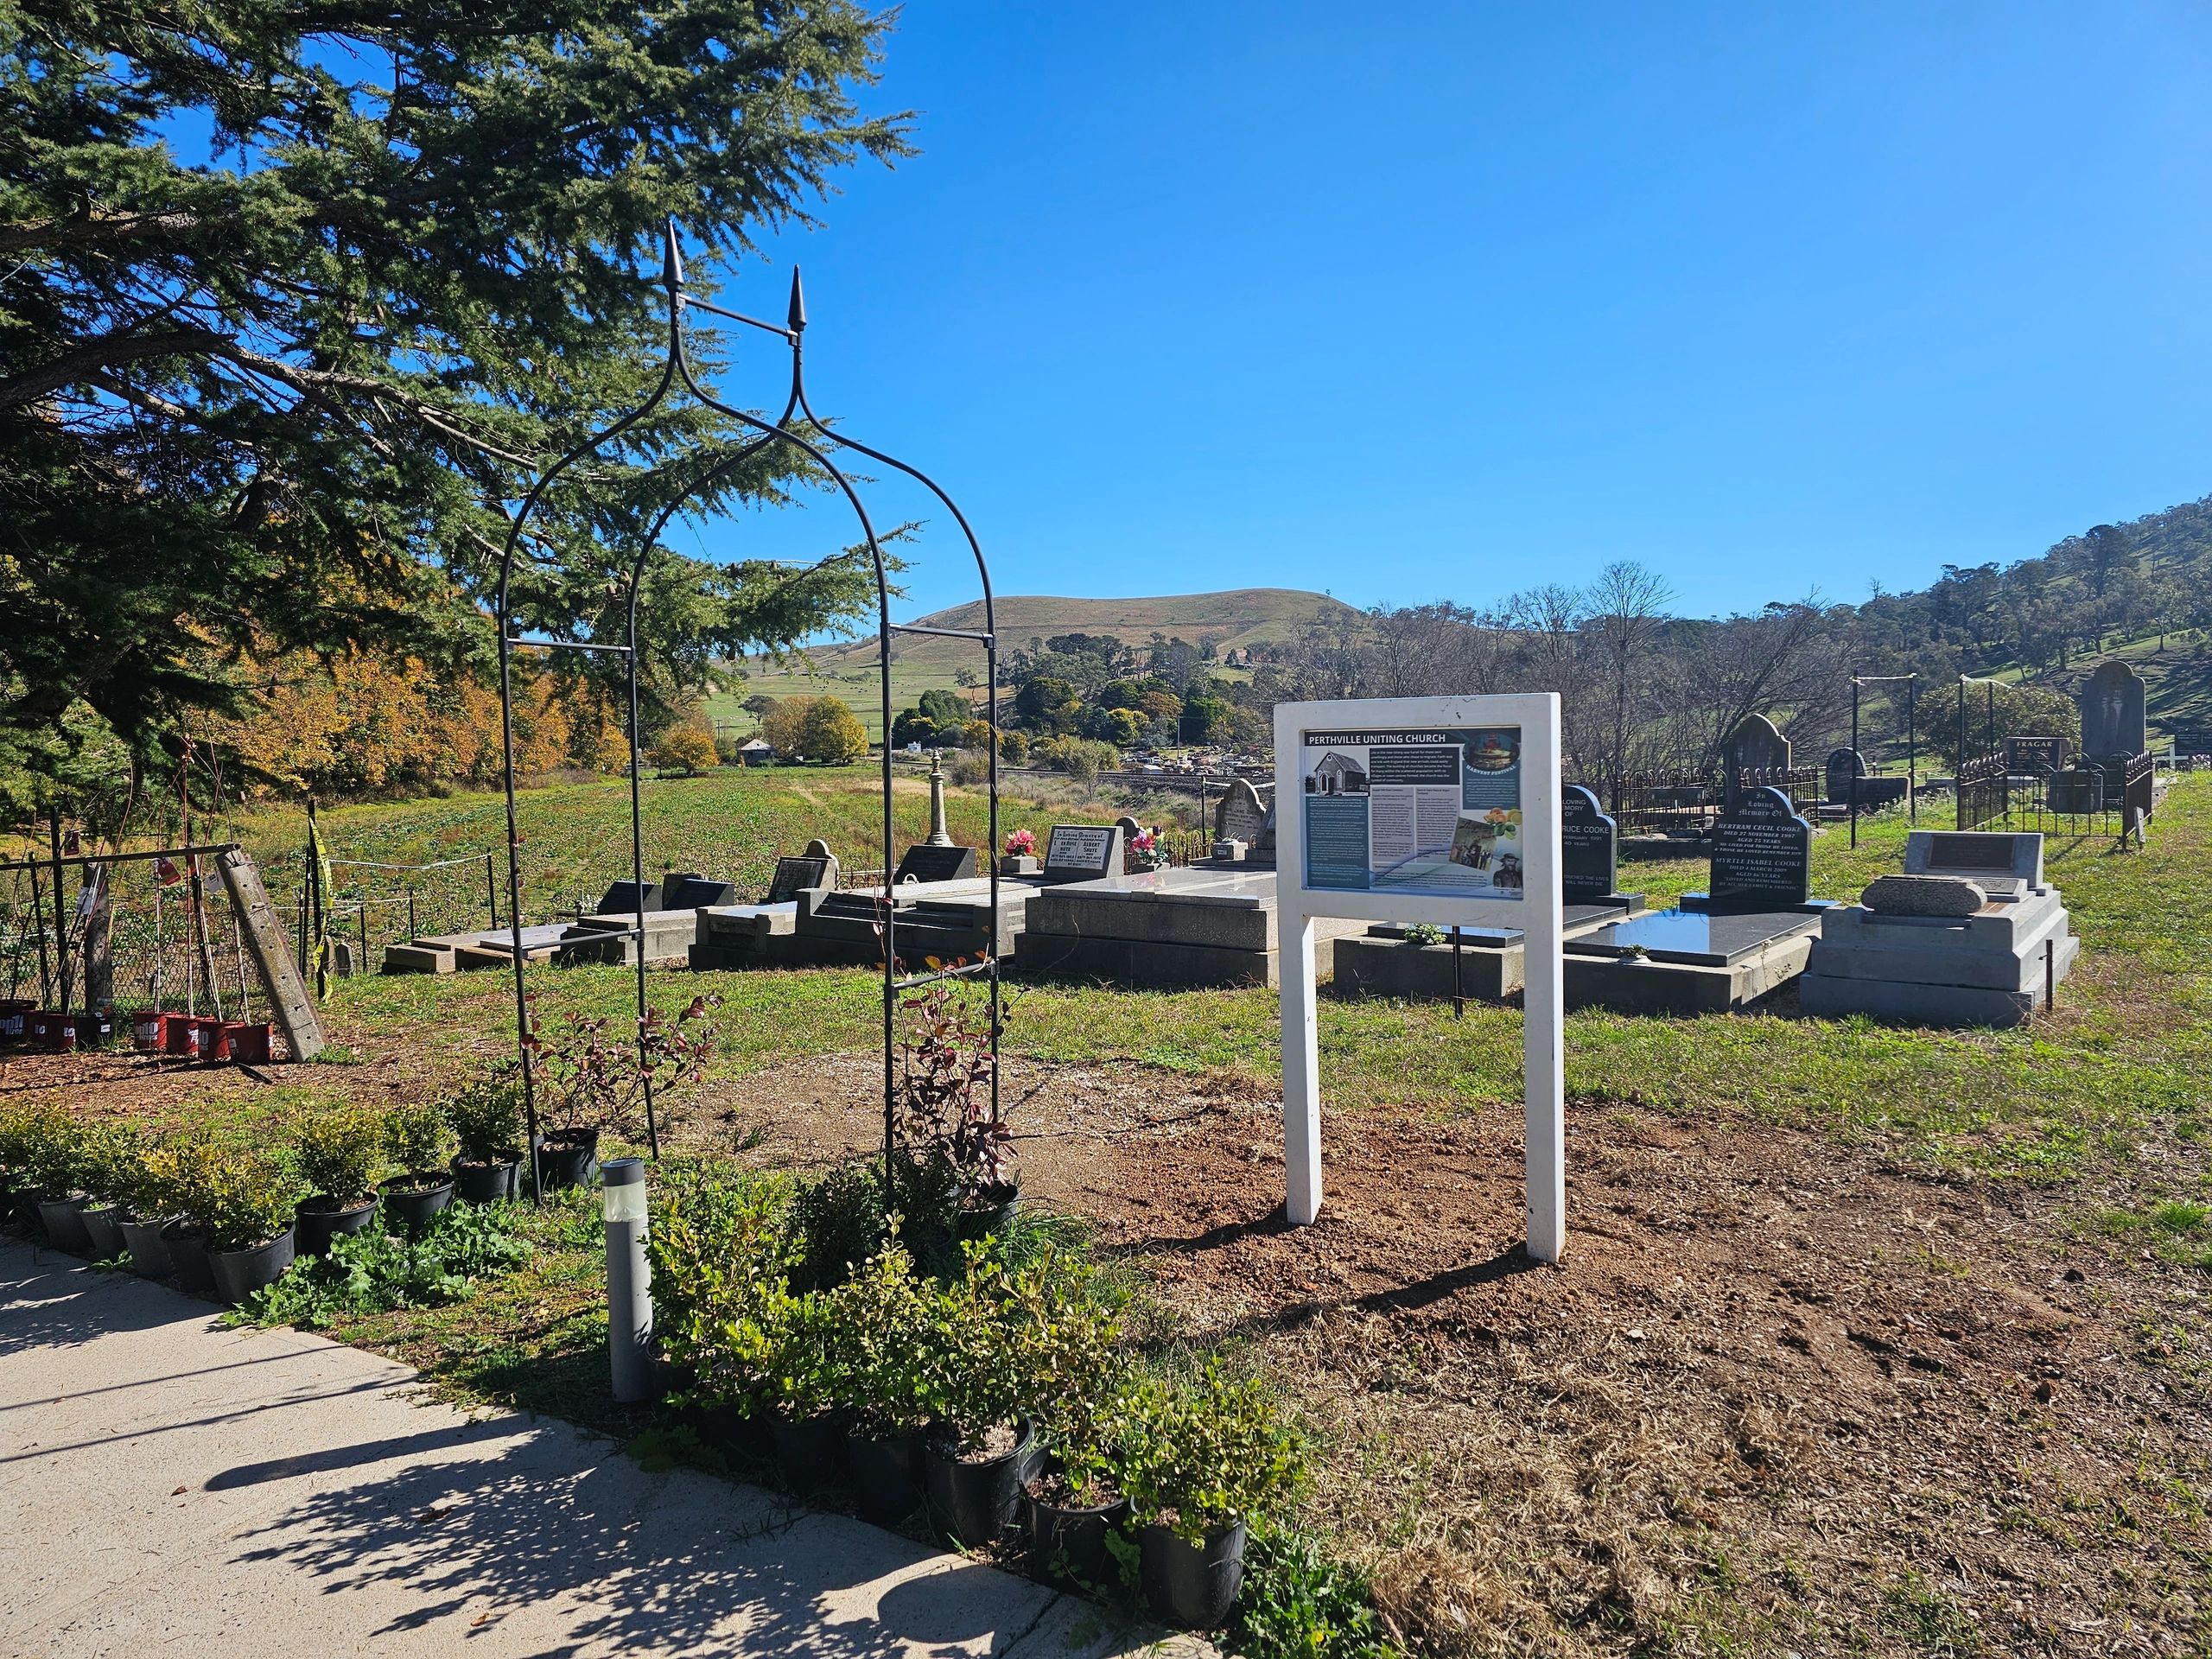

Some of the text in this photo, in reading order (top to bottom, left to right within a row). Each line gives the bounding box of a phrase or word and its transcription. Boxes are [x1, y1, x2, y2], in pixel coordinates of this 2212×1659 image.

[1309, 734, 1446, 745] PERTHVILLE UNITING CHURCH
[1491, 765, 1516, 775] FESTIVAL
